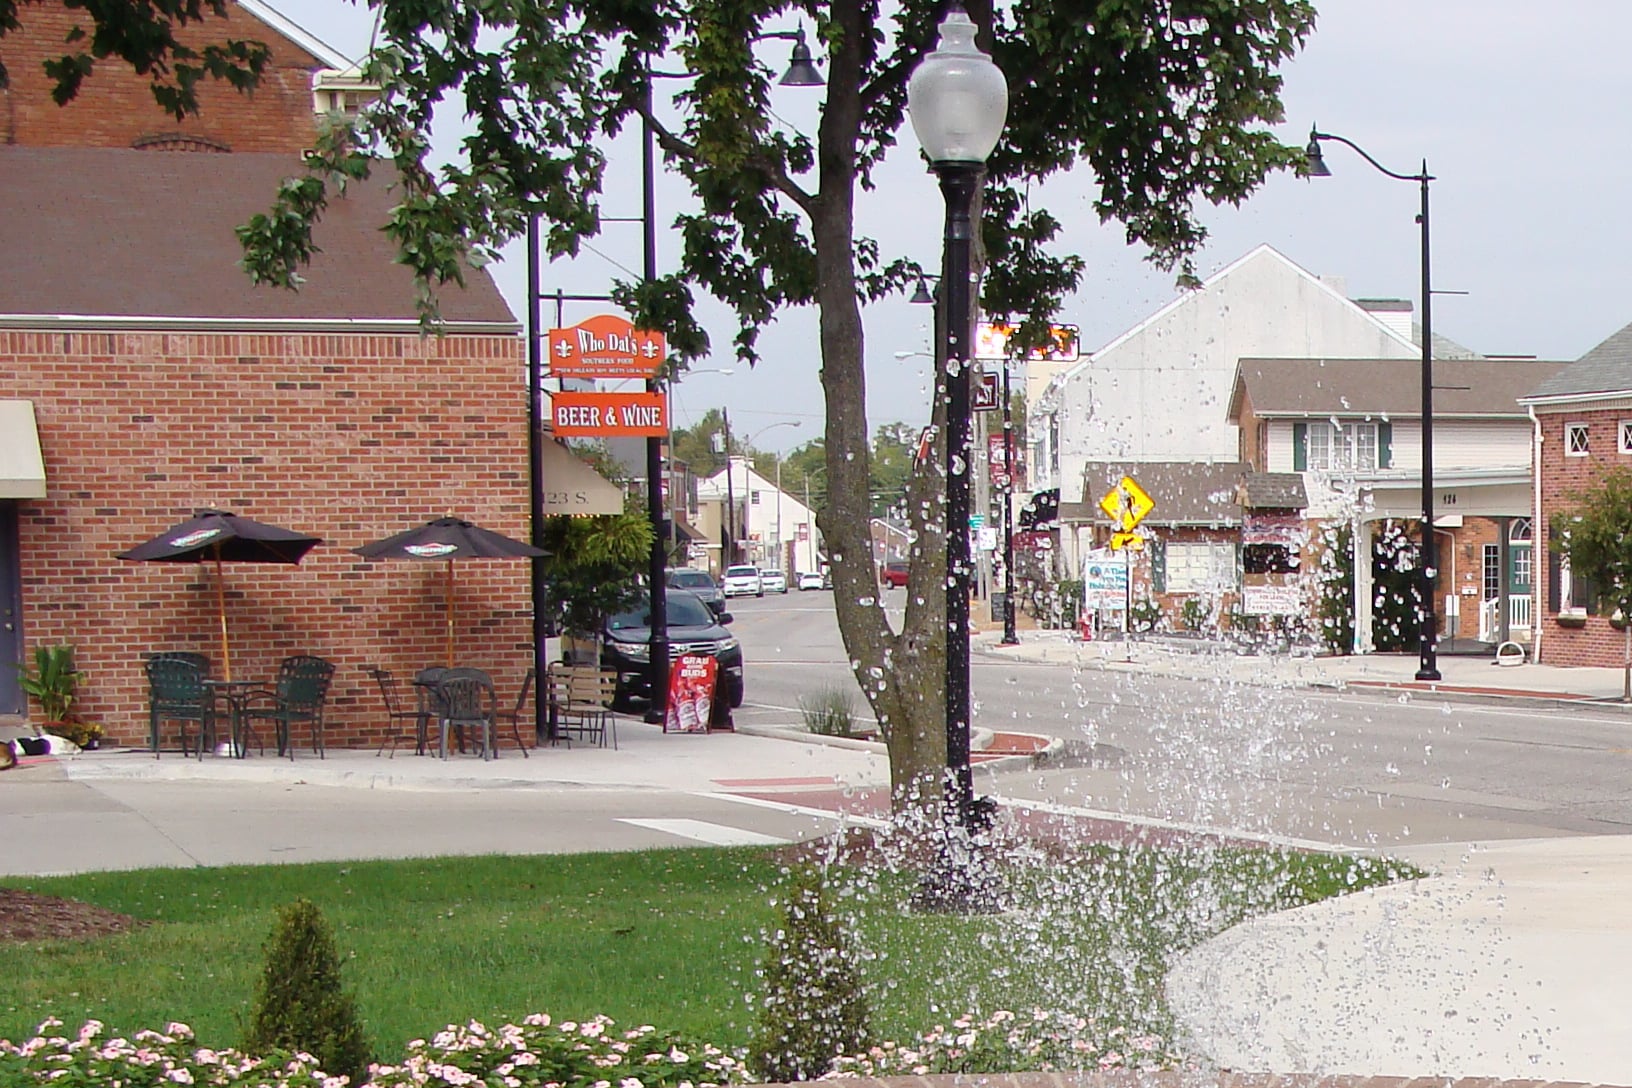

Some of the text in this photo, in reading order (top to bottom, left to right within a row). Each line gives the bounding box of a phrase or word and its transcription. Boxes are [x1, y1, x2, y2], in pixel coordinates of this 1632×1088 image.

[577, 328, 638, 356] Who Dat's
[557, 403, 662, 427] BEER & WINE
